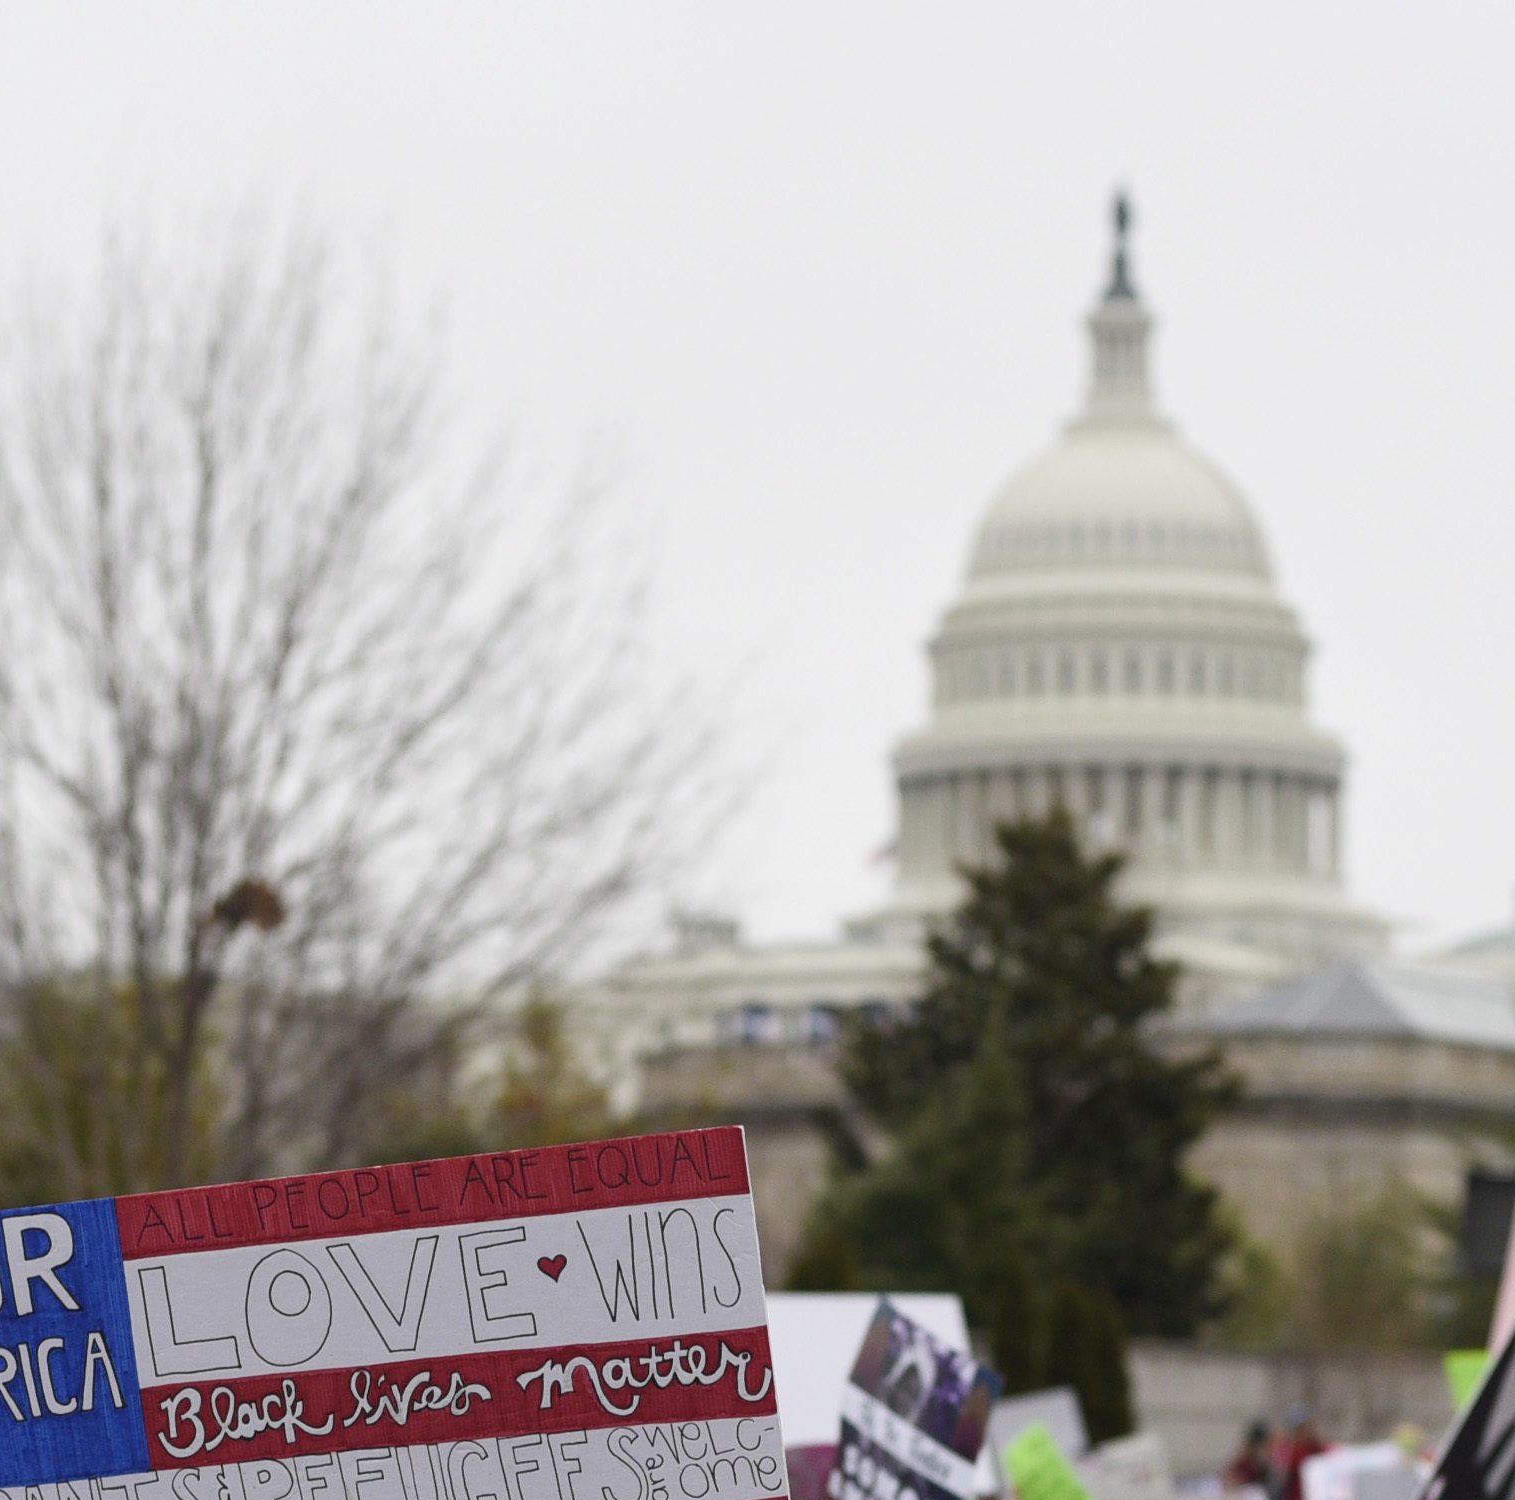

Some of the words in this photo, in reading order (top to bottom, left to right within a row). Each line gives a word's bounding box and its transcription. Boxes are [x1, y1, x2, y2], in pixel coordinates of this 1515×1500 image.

[137, 1195, 233, 1248] ALL
[252, 1164, 439, 1231] PEOPLE
[459, 1152, 548, 1207] ARE
[567, 1134, 731, 1195] EQUAL
[137, 1226, 538, 1378] LOVE
[157, 1378, 335, 1460] Black
